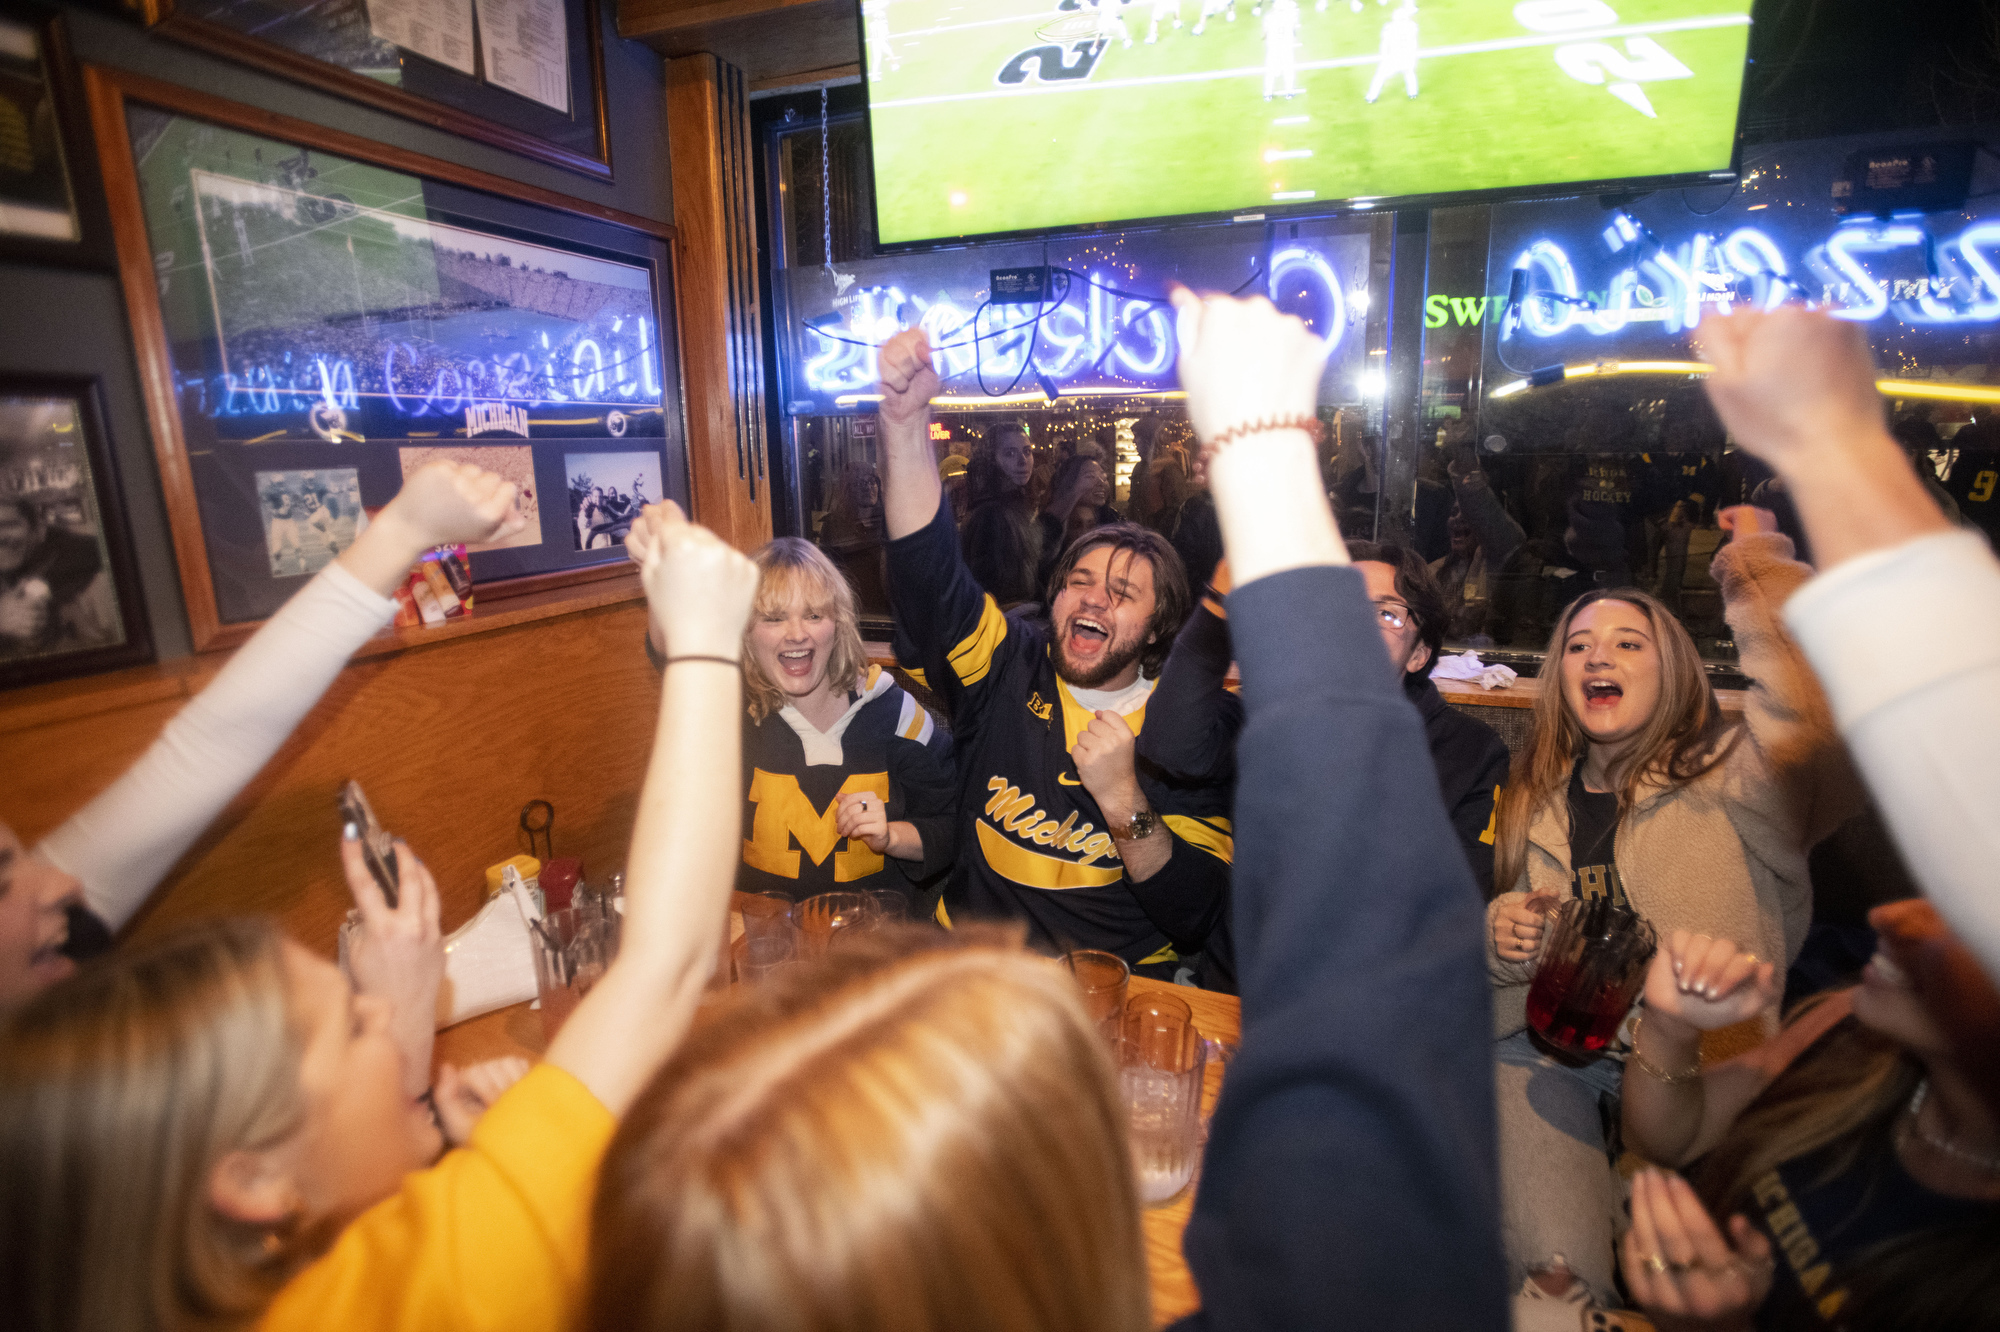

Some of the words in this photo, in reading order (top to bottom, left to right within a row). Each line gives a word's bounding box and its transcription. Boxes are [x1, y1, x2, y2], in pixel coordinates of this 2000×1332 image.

[464, 402, 530, 439] MICHIGAN
[1968, 470, 1998, 502] 9
[742, 766, 889, 882] M
